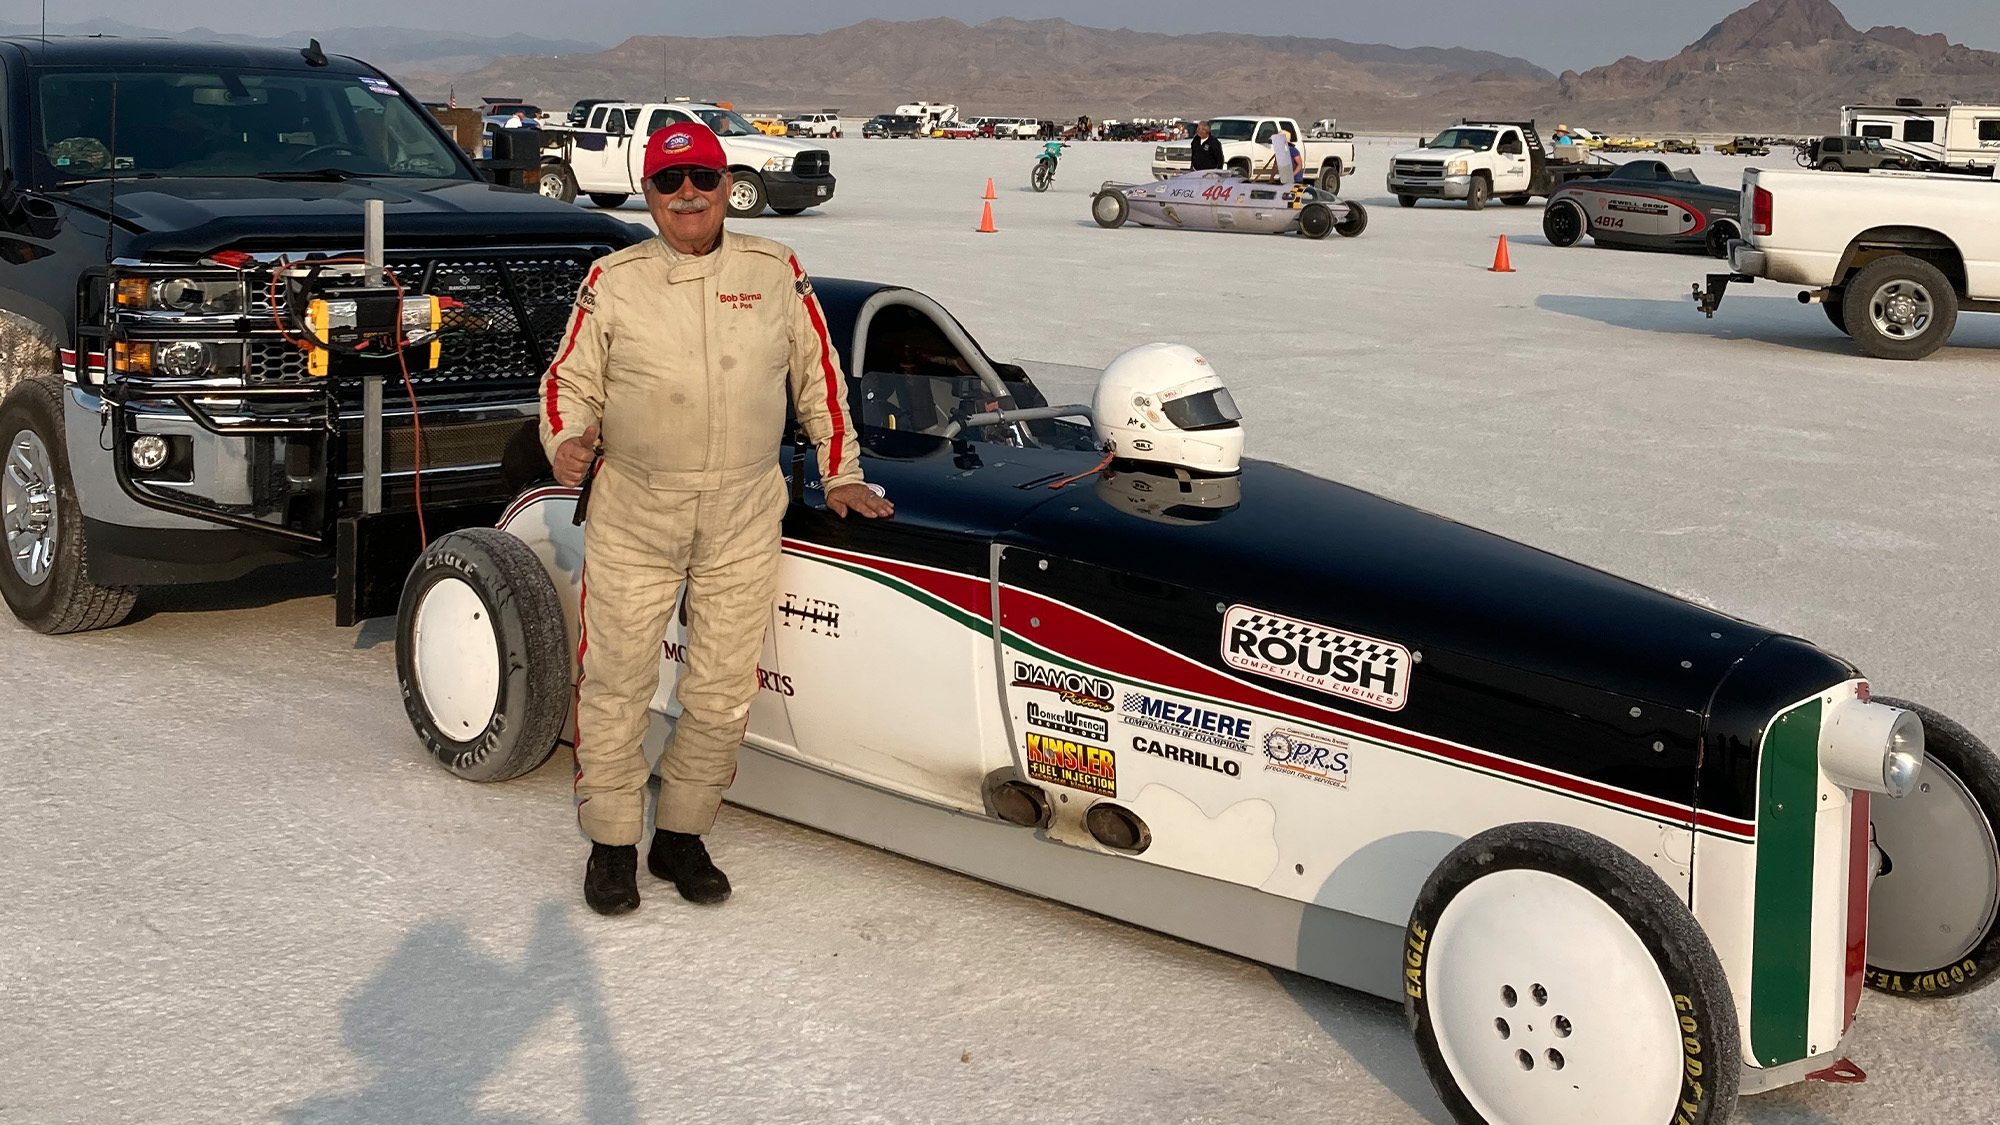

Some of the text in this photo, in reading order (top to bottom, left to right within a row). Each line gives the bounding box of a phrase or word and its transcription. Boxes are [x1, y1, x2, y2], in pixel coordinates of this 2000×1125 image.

[1202, 185, 1233, 201] 404
[1608, 199, 1639, 207] JEWELL
[1642, 202, 1669, 210] GROUP
[1595, 215, 1624, 228] 4814
[720, 294, 738, 303] Bob
[1127, 417, 1139, 426] A+
[426, 549, 478, 578] EAGLE
[1229, 627, 1397, 696] ROUSH
[1014, 661, 1114, 701] DIAMOND
[1231, 655, 1394, 705] COMPETITION ENGINES
[1060, 690, 1113, 712] Pistons
[1141, 696, 1252, 740] MEZIERE
[1123, 716, 1248, 752] COMPONENTS OF CHAMPIONS
[1027, 733, 1115, 780] KINSLER
[1132, 736, 1240, 777] CARRILLO
[1292, 743, 1349, 774] P.R.S.
[1031, 762, 1058, 777] FUEL
[1062, 769, 1115, 790] INJECTION
[1264, 764, 1296, 776] precision
[1297, 772, 1312, 780] race
[1313, 776, 1340, 787] services
[1406, 921, 1428, 999] EAGLE
